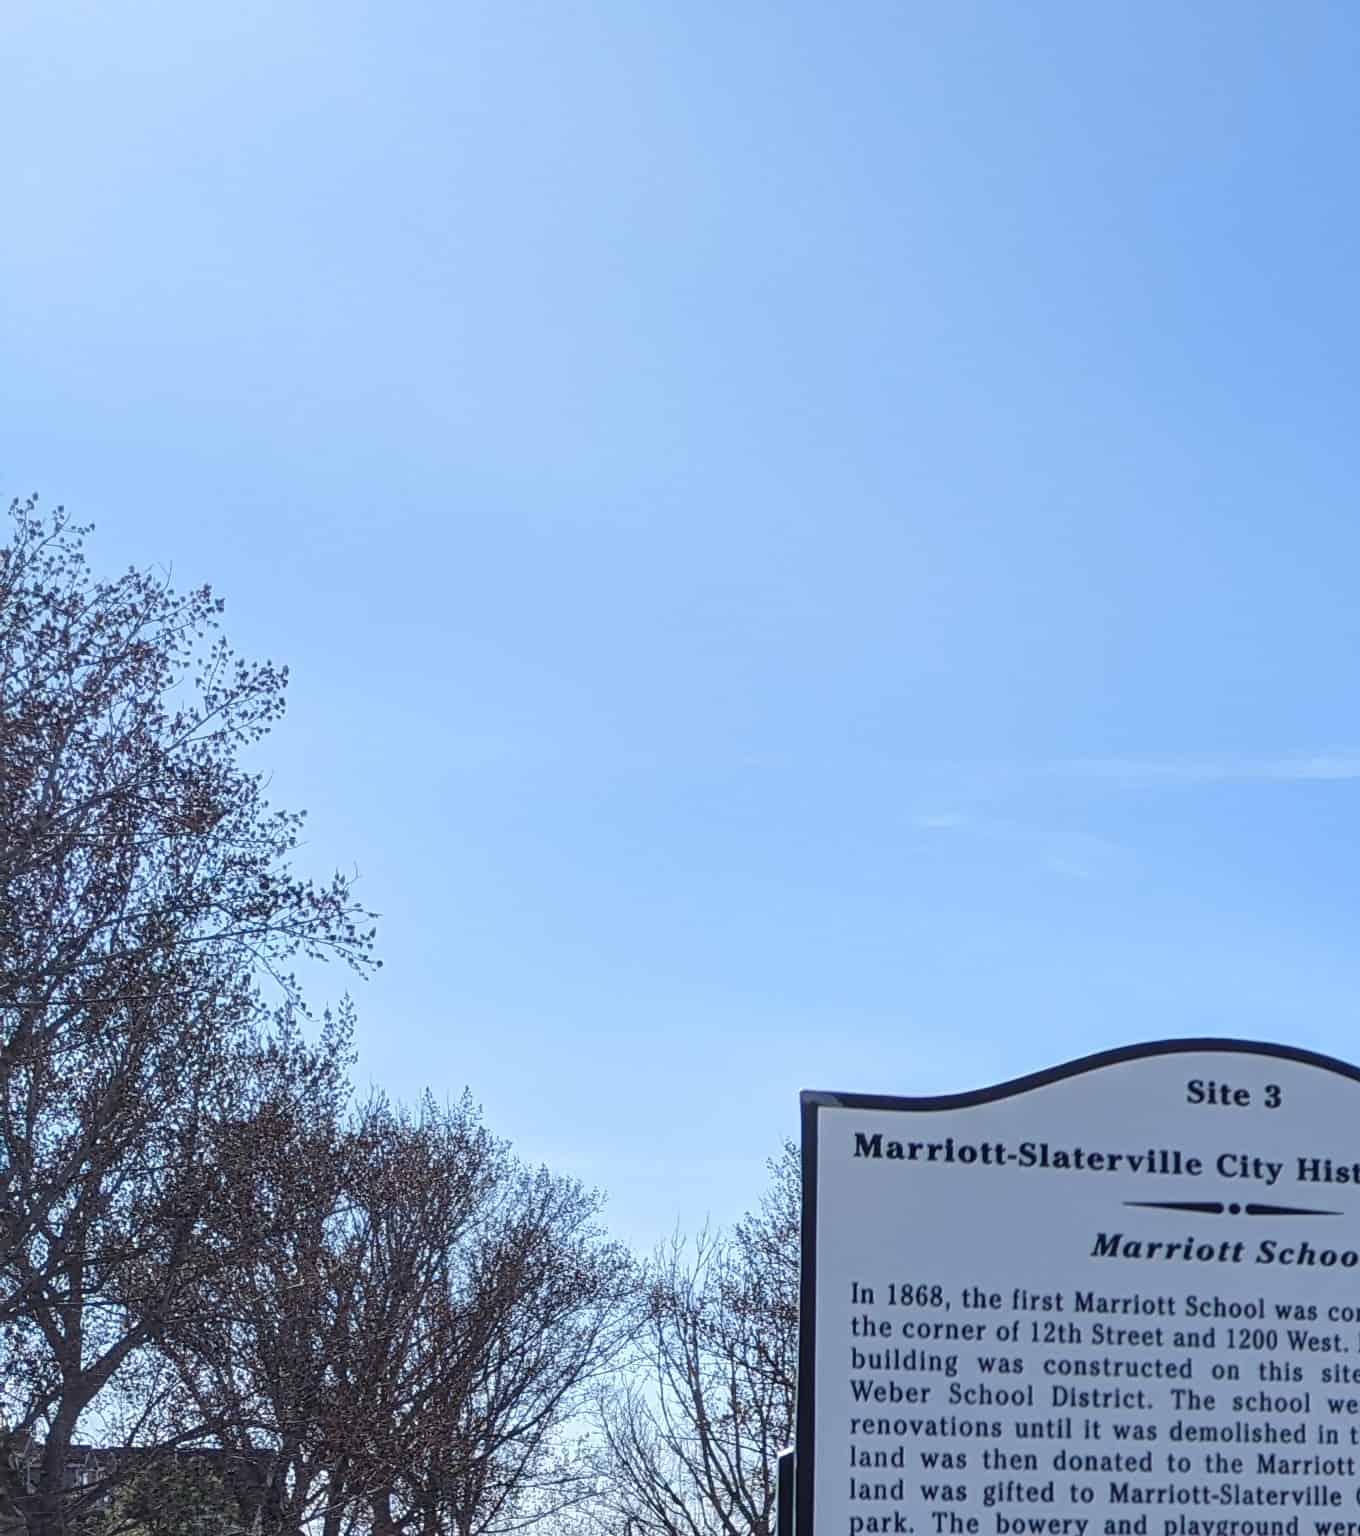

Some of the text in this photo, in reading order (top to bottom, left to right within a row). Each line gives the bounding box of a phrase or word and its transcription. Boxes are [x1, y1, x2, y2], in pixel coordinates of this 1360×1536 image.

[1186, 1079, 1282, 1109] Site 3
[853, 1132, 1203, 1177] Marriott-Slaterville
[1216, 1153, 1284, 1186] City
[1090, 1232, 1245, 1263] Marriott
[851, 1281, 875, 1305] In
[887, 1283, 951, 1312] 1868,
[961, 1286, 1002, 1310] the
[1012, 1287, 1064, 1312] first
[1074, 1290, 1176, 1317] Marriott
[1185, 1295, 1265, 1320] School
[1274, 1304, 1318, 1321] was
[851, 1314, 892, 1339] the
[902, 1322, 987, 1341] corner
[995, 1319, 1020, 1342] of
[1031, 1321, 1082, 1345] 12th
[1091, 1322, 1164, 1347] Street
[1173, 1327, 1216, 1349] and
[1227, 1327, 1278, 1351] 1200
[1286, 1329, 1349, 1353] West.
[851, 1347, 958, 1378] building
[976, 1356, 1024, 1374] was
[1043, 1357, 1193, 1379] constructed
[1211, 1364, 1240, 1381] on
[1259, 1359, 1304, 1383] this
[849, 1379, 931, 1404] Weber
[948, 1382, 1033, 1407] School
[1052, 1385, 1153, 1410] District.
[1170, 1388, 1216, 1411] The
[1232, 1391, 1311, 1414] school
[850, 1415, 1002, 1438] renovations
[1015, 1417, 1072, 1439] until
[1084, 1419, 1101, 1441] it
[1112, 1424, 1158, 1441] was
[1169, 1419, 1307, 1444] demolished
[1318, 1424, 1339, 1445] in
[849, 1445, 905, 1469] land
[919, 1452, 967, 1470] was
[983, 1447, 1038, 1471] then
[1052, 1449, 1153, 1473] donated
[1167, 1453, 1192, 1474] to
[1205, 1452, 1244, 1474] the
[1257, 1453, 1355, 1477] Marriott
[849, 1477, 904, 1501] land
[919, 1484, 968, 1502] was
[983, 1479, 1055, 1508] gifted
[1069, 1484, 1095, 1504] to
[1109, 1481, 1342, 1507] Marriott-Slaterville
[931, 1511, 979, 1535] The
[1103, 1513, 1148, 1536] and
